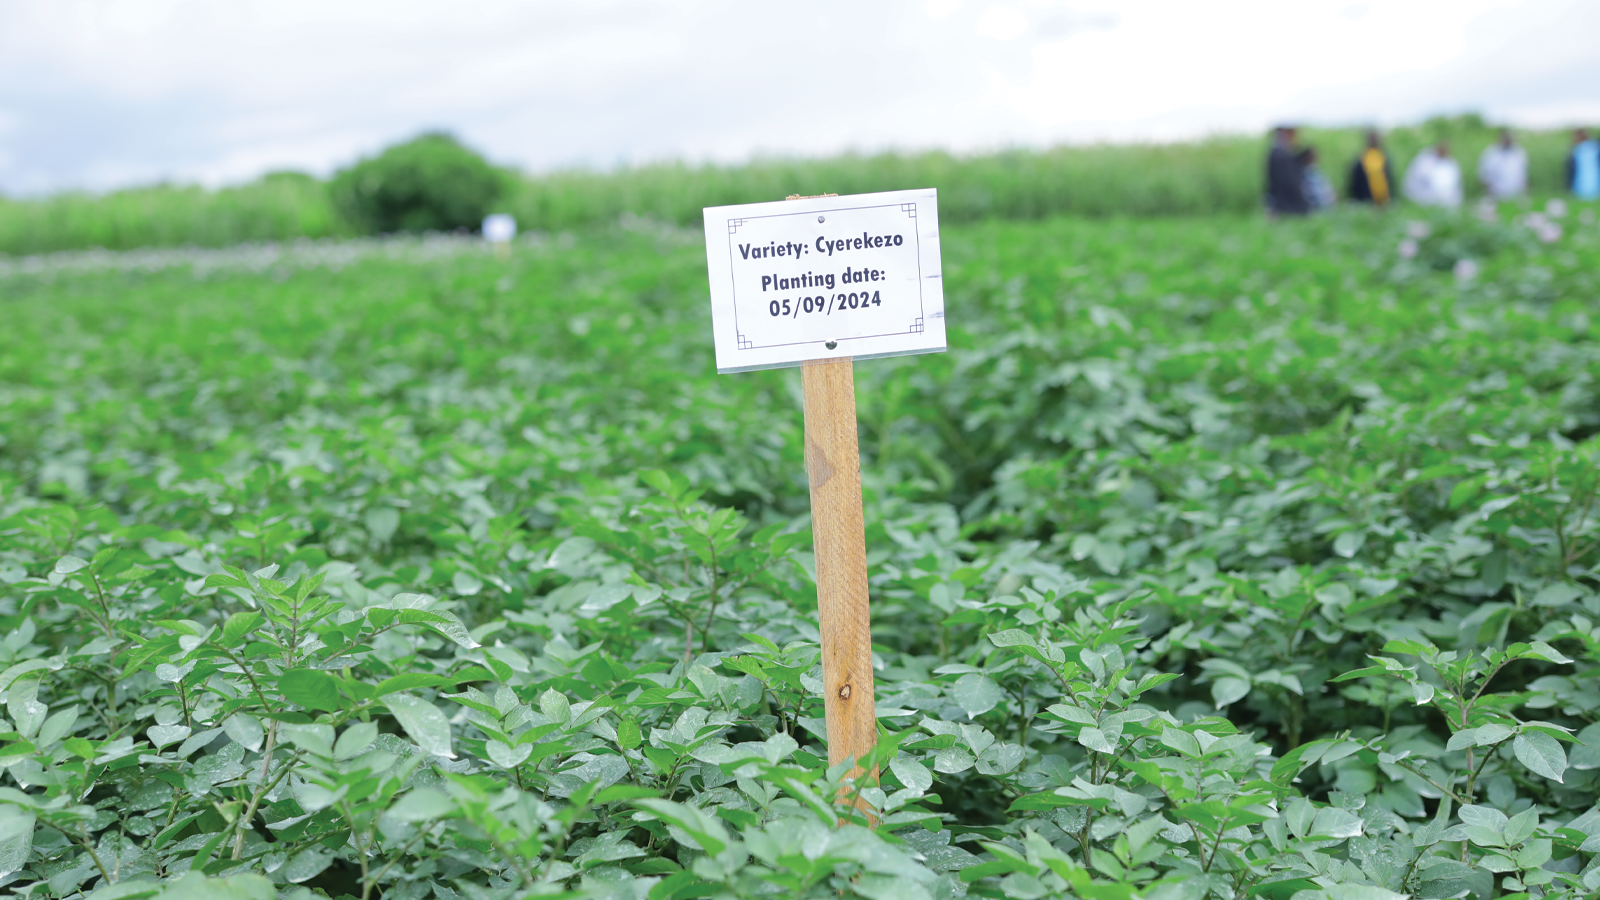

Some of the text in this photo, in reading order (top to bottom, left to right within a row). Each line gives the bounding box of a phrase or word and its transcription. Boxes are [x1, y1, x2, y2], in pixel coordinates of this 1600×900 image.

[738, 232, 904, 260] Variety: Cyerekezo
[761, 266, 886, 292] Planting date:
[769, 290, 882, 319] 05/09/2024
